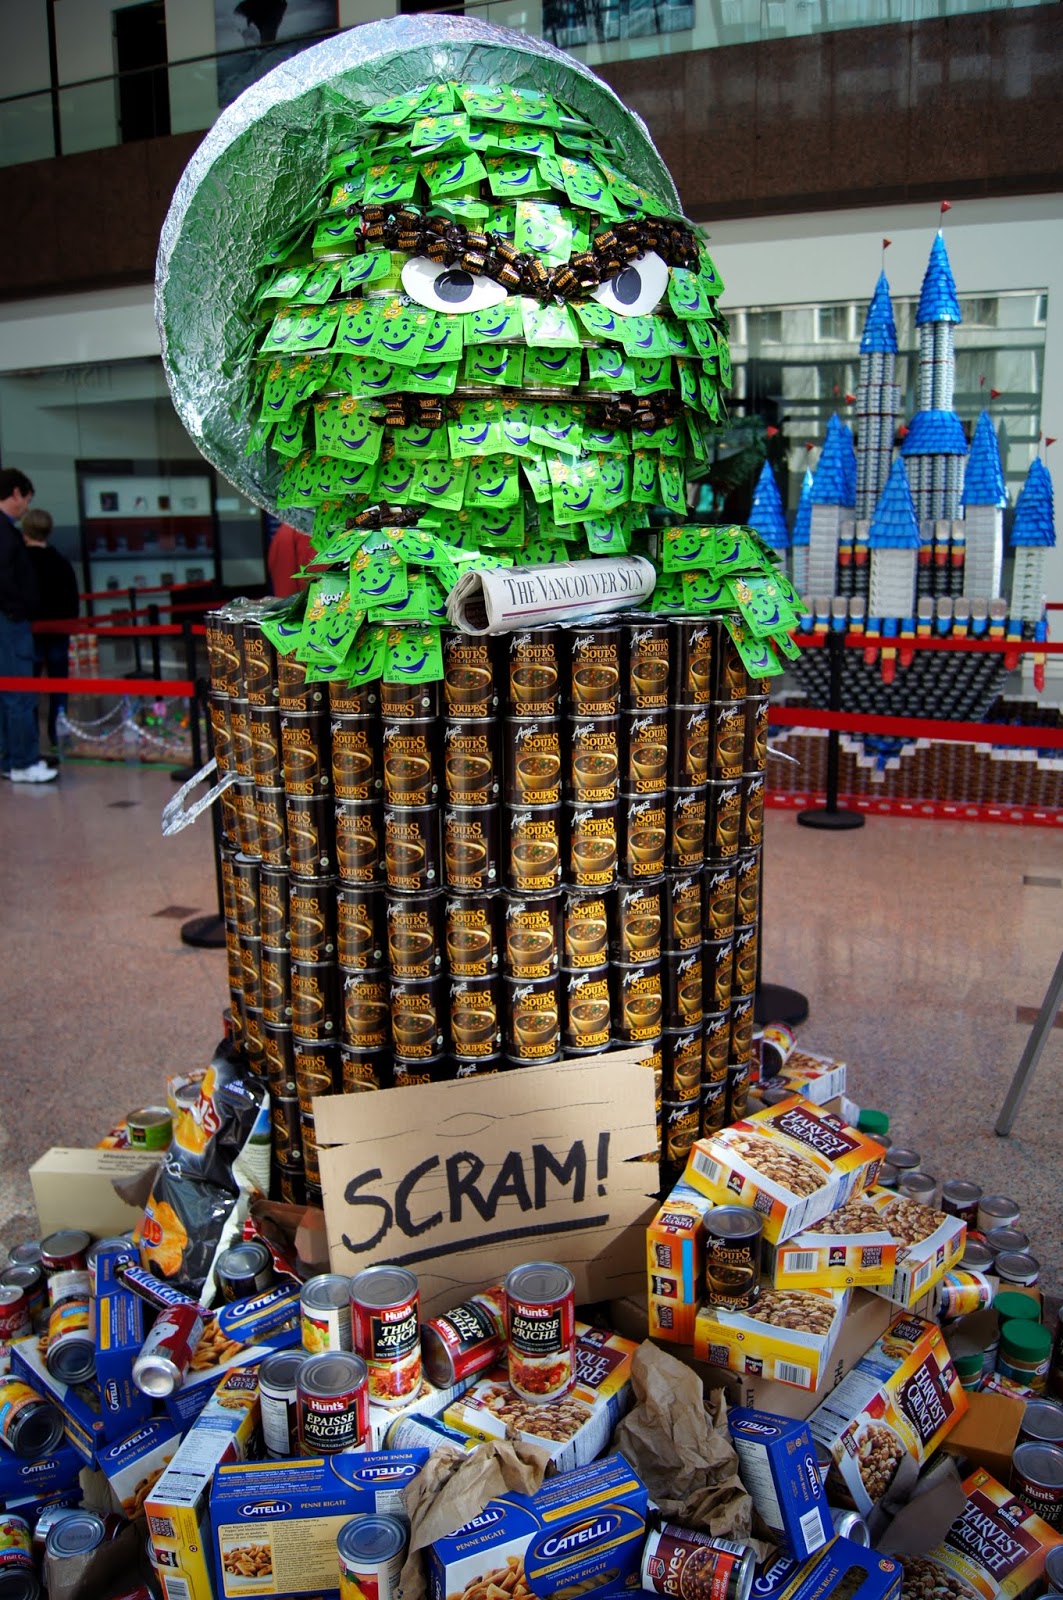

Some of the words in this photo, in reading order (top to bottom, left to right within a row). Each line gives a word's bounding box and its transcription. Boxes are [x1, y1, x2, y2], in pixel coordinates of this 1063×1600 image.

[503, 578, 538, 606] THE
[536, 572, 617, 601] VANCOUVER
[618, 567, 643, 592] SUN
[450, 646, 487, 659] SOUPS
[517, 644, 554, 658] SOUPS
[580, 644, 616, 658] SOUPS
[382, 705, 414, 717] SOUPES
[449, 704, 487, 717] SOUPES
[515, 702, 555, 716] SOUPES
[577, 702, 615, 716] SOUPES
[388, 735, 425, 749] SOUPS
[450, 735, 487, 749] SOUPS
[524, 733, 558, 748] SOUPS
[580, 732, 616, 747] SOUPS
[389, 791, 426, 804] SOUPES
[450, 791, 487, 804] SOUPES
[522, 789, 558, 804] SOUPES
[577, 787, 615, 802] SOUPES
[338, 815, 371, 828] SOUPS
[447, 823, 481, 835] SOUPS
[518, 821, 555, 835] SOUPS
[580, 818, 614, 832] SOUPS
[387, 876, 421, 889] SOUPES
[517, 875, 555, 889] SOUPES
[576, 871, 613, 885] SOUPES
[573, 901, 605, 915] SOUPS
[392, 912, 428, 924] SOUPS
[450, 910, 485, 922] SOUPS
[514, 911, 549, 924] SOUPS
[512, 964, 550, 978] SOUPES
[577, 980, 607, 996] SOUPS
[395, 994, 430, 1006] SOUPS
[455, 991, 491, 1003] SOUPS
[521, 991, 555, 1007] SOUPS
[519, 1043, 555, 1058] SOUPES
[780, 1119, 836, 1155] CRUNCH
[783, 1110, 852, 1152] HARVEST
[341, 1132, 610, 1254] SCRAM!
[713, 1247, 750, 1259] SOUPS
[233, 1286, 290, 1316] CATELLI
[710, 1293, 749, 1308] SOUPES
[385, 1306, 412, 1321] Hunt's
[518, 1305, 549, 1316] Hunt's
[250, 1318, 273, 1333] PENNE
[381, 1314, 417, 1336] THICK
[513, 1317, 559, 1332] ÉPAISSE
[226, 1381, 256, 1389] NATURE
[110, 1382, 119, 1411] CATELLI
[914, 1364, 947, 1428] HARVEST
[311, 1400, 344, 1411] Hunt's
[908, 1384, 935, 1438] CRUNCH
[306, 1411, 355, 1426] ÉPAISSE
[737, 1420, 777, 1435] CATELLI
[110, 1427, 154, 1457] CATELLI
[21, 1462, 55, 1475] CATELLI
[362, 1465, 416, 1477] CATELLI
[806, 1458, 818, 1495] CATELLI
[1025, 1485, 1055, 1500] Hunt's
[243, 1505, 285, 1516] CATELLI
[998, 1508, 1020, 1527] QUAKER
[543, 1520, 611, 1556] CATELLI
[964, 1500, 1029, 1563] HARVEST
[456, 1539, 480, 1551] PENNE
[480, 1529, 506, 1542] RIGATE
[950, 1518, 1008, 1571] CRUNCH
[556, 1573, 580, 1586] PENNE
[582, 1562, 607, 1577] RIGATE
[663, 1548, 686, 1597] Fêves
[754, 1556, 794, 1592] CATEL
[821, 1567, 839, 1587] RIGATE
